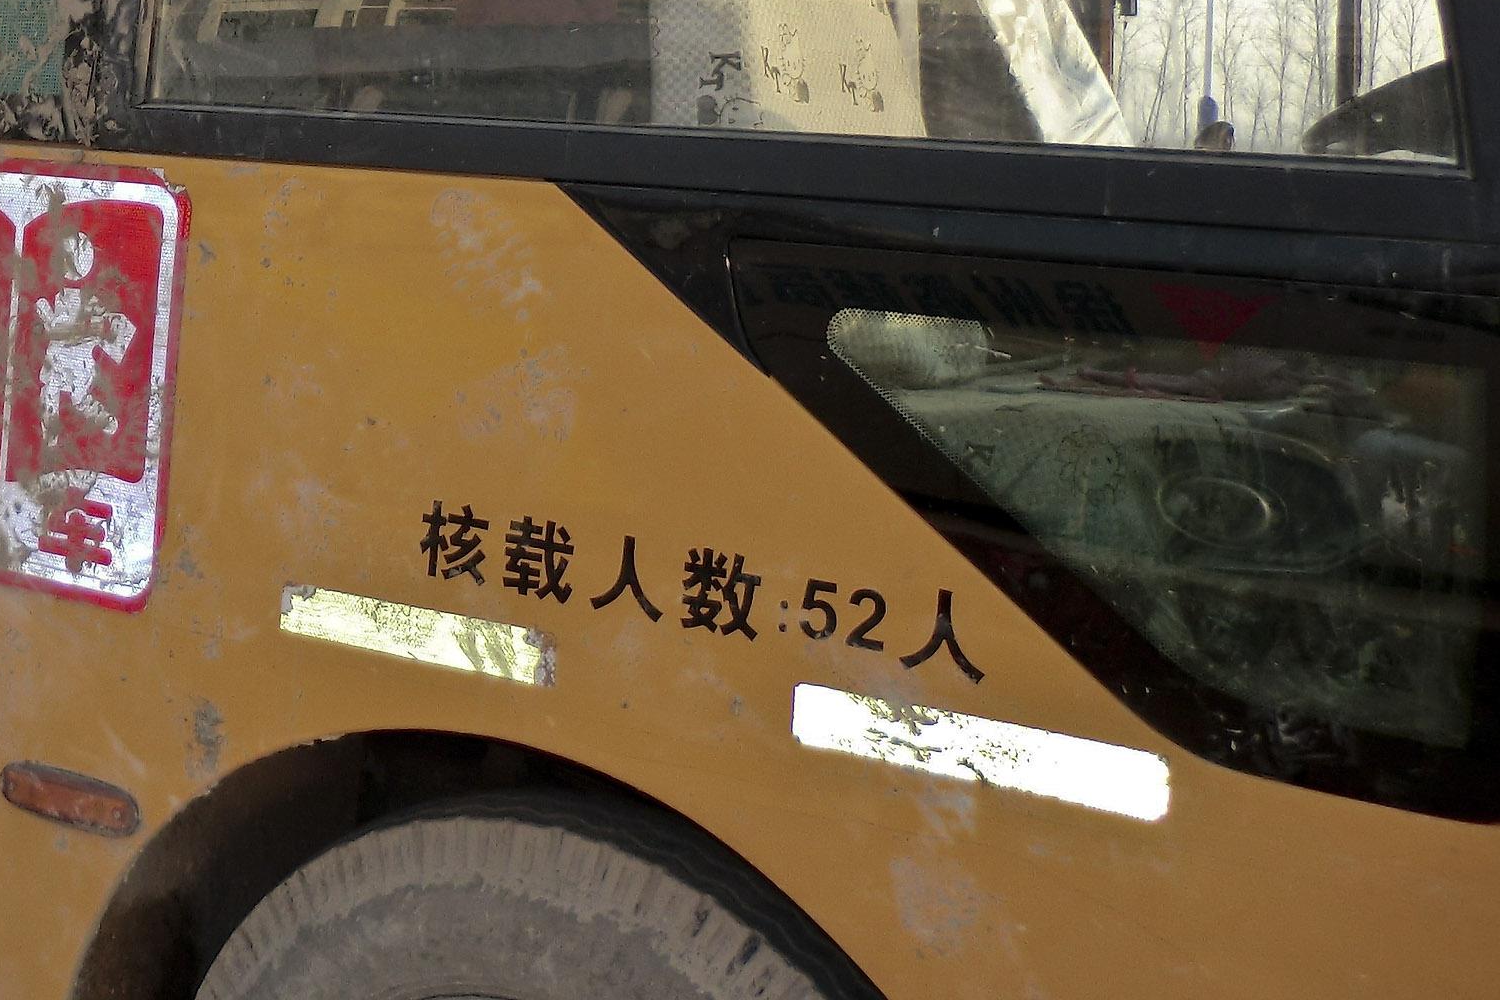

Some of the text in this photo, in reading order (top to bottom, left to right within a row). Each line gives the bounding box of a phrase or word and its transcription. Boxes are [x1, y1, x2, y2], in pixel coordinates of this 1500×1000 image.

[700, 50, 742, 92] KT
[760, 44, 782, 94] KT
[838, 62, 859, 107] KT
[419, 499, 986, 685] 核载人数:52人
